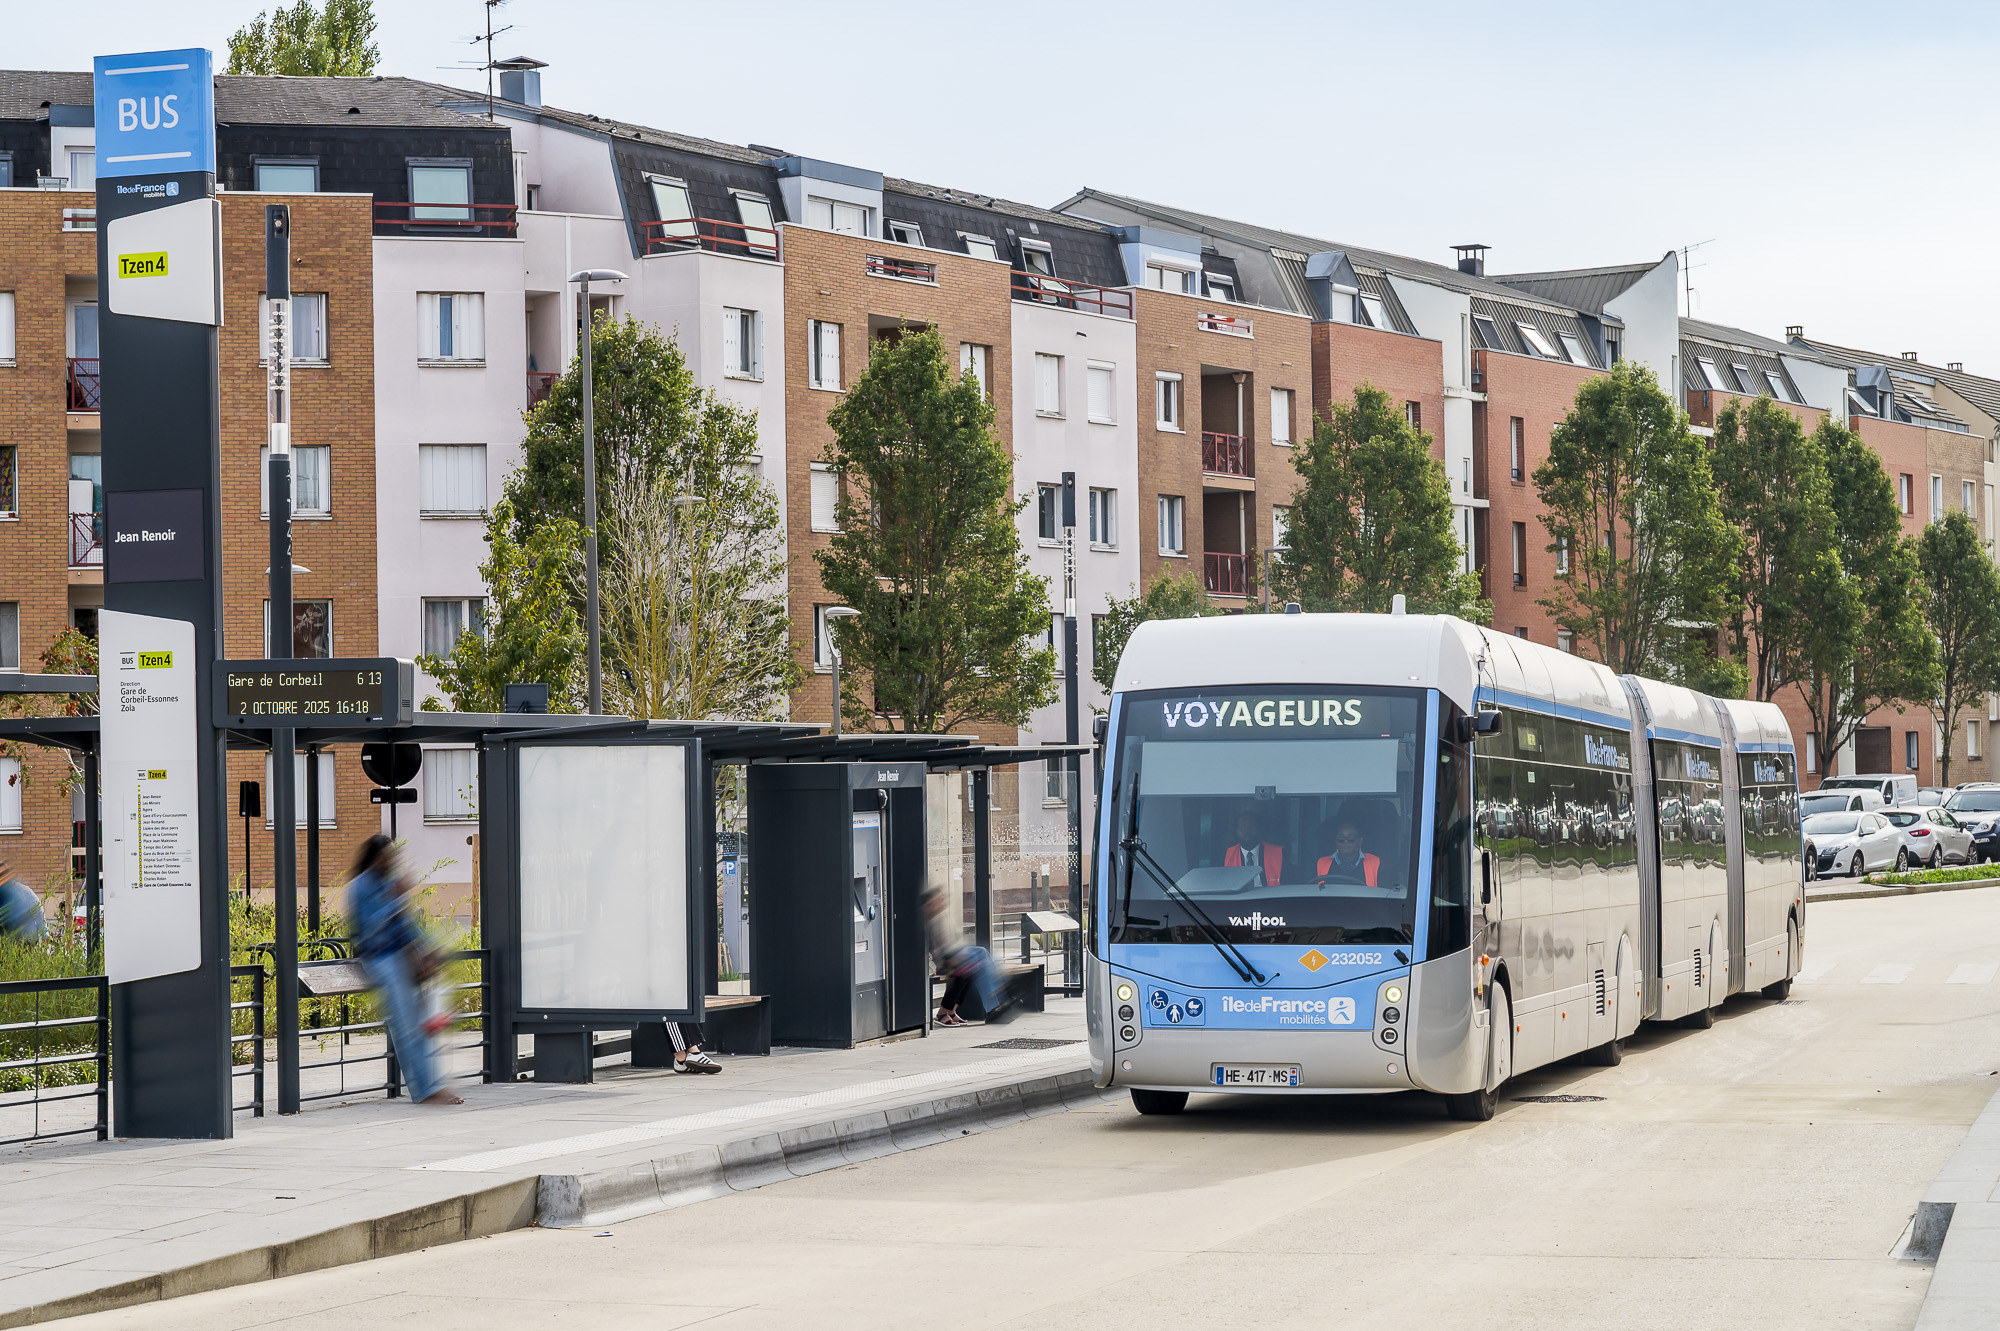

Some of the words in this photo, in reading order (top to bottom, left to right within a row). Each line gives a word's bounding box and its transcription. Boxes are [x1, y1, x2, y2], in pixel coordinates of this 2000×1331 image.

[118, 94, 179, 132] BUS
[143, 191, 166, 199] mobilités
[114, 531, 139, 543] Jean
[141, 529, 176, 542] Renoir
[121, 657, 134, 665] BUS
[228, 673, 254, 687] Gare
[260, 673, 273, 686] de
[279, 672, 323, 686] Corbeil
[357, 672, 364, 685] 6
[368, 671, 382, 685] 13
[138, 687, 147, 695] de
[120, 695, 179, 704] Corbeil-Essonnes
[240, 701, 247, 715] 2
[252, 701, 298, 715] OCTOBRE
[304, 701, 330, 714] 2025
[336, 701, 369, 714] 16:18
[1163, 699, 1362, 728] VOYAGEURS
[725, 861, 735, 875] P
[1331, 953, 1382, 965] 232052
[1221, 996, 1326, 1013] îledeFrance
[1280, 1014, 1326, 1025] mobilités
[1290, 1076, 1297, 1084] 75
